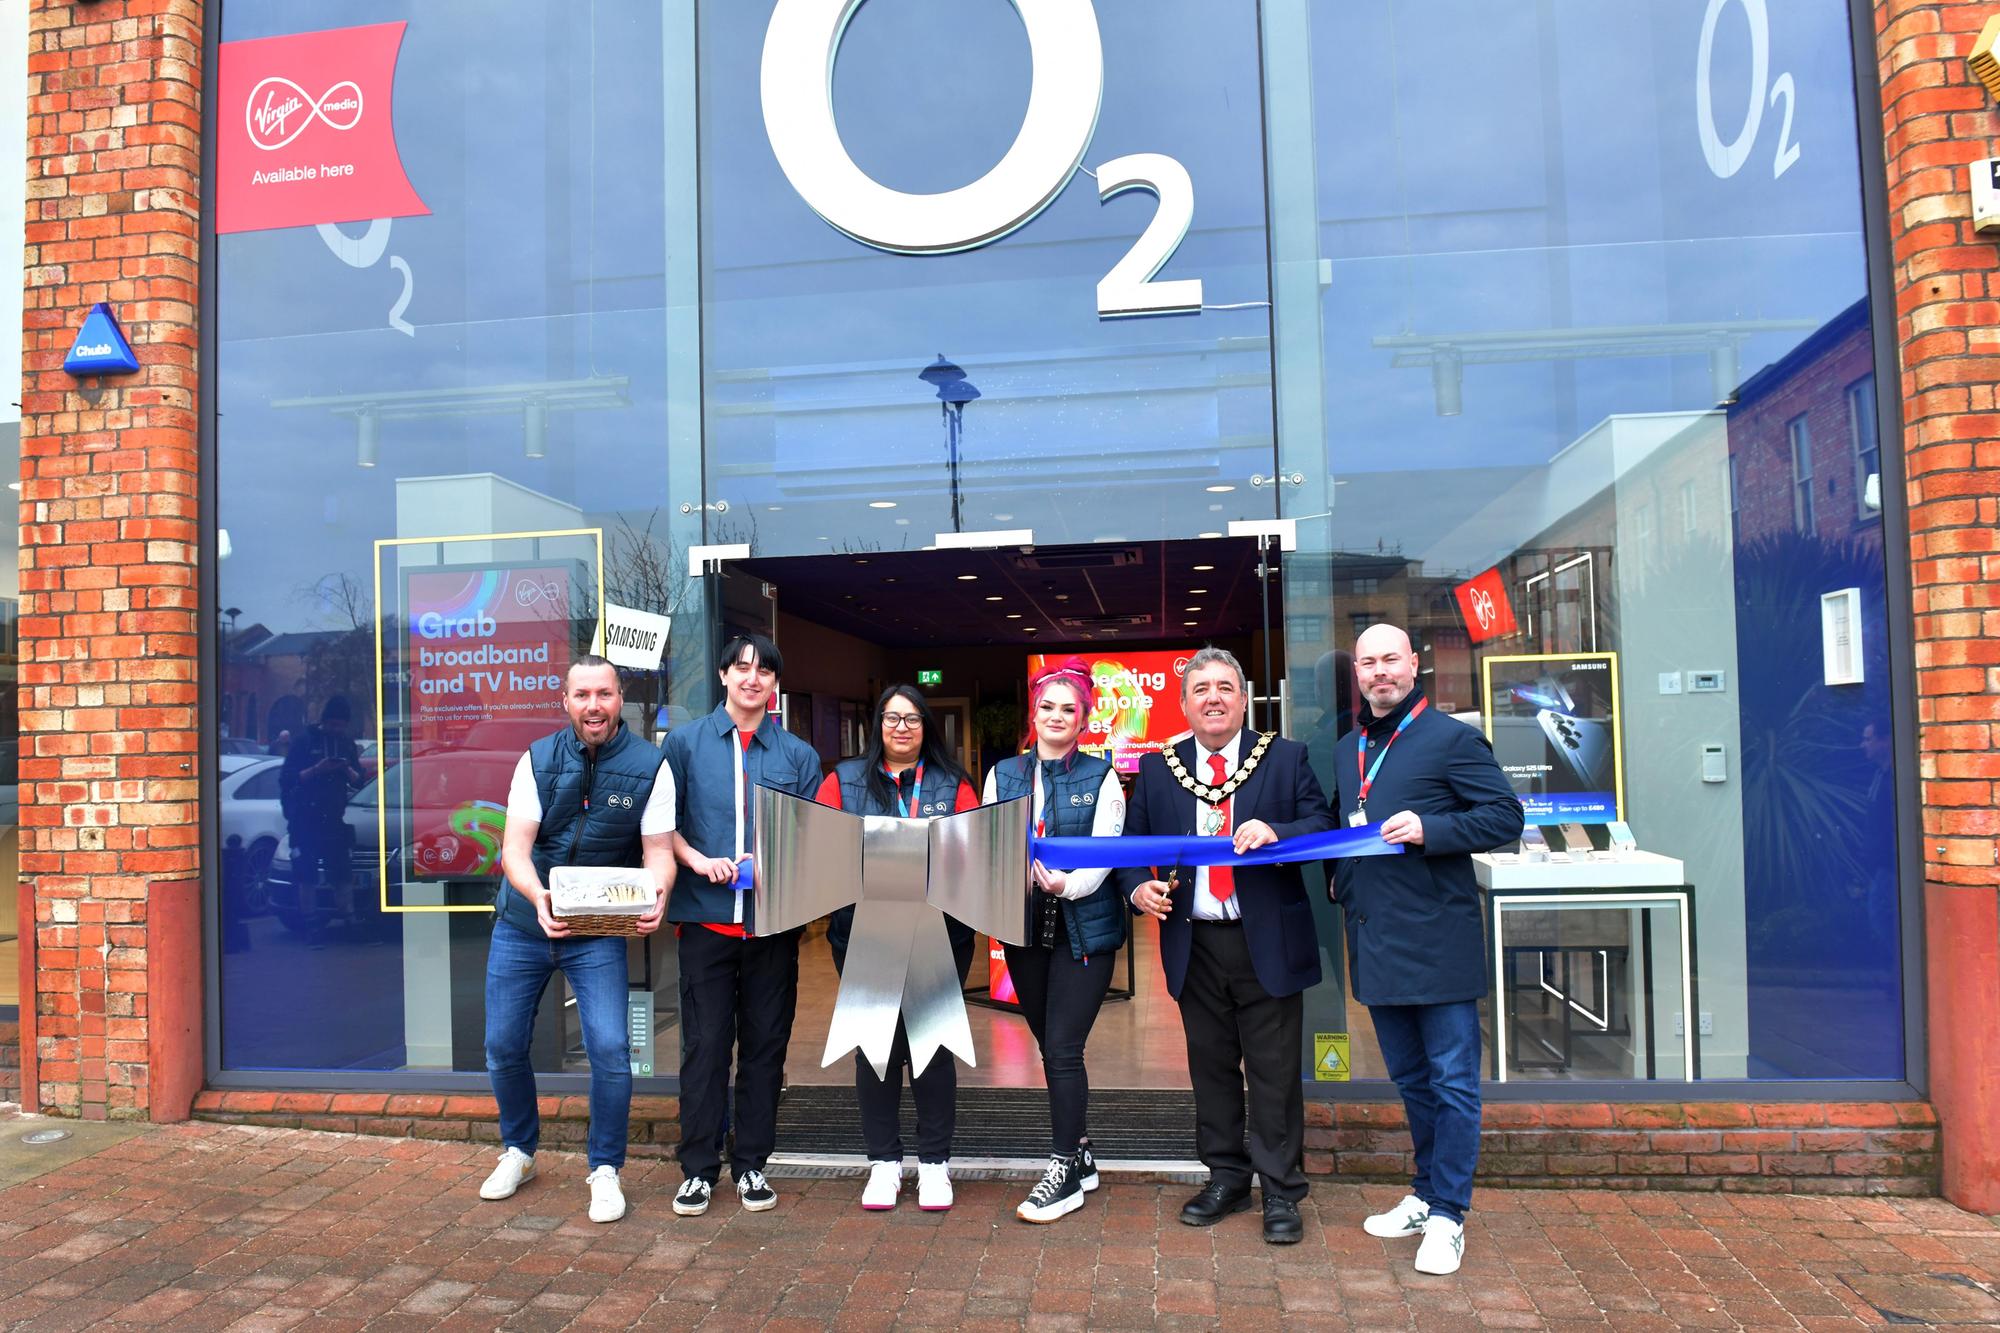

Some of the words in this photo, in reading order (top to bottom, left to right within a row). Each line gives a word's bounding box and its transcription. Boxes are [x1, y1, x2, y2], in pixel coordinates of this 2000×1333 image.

[255, 90, 303, 136] Virgin
[323, 98, 358, 112] media
[252, 165, 317, 185] Available
[320, 163, 354, 178] here
[75, 343, 112, 357] Chubb
[418, 609, 497, 639] Grab
[606, 623, 658, 652] SAMSUNG
[420, 642, 548, 667] broadband
[1571, 663, 1607, 671] SAMSUNG
[420, 673, 464, 694] and
[470, 671, 503, 693] TV
[509, 670, 560, 692] here
[434, 704, 463, 712] exclusive
[464, 703, 482, 711] offers
[509, 702, 535, 711] already
[535, 701, 550, 709] with
[1097, 695, 1154, 710] more
[1115, 761, 1130, 769] full
[1502, 765, 1526, 773] Galaxy
